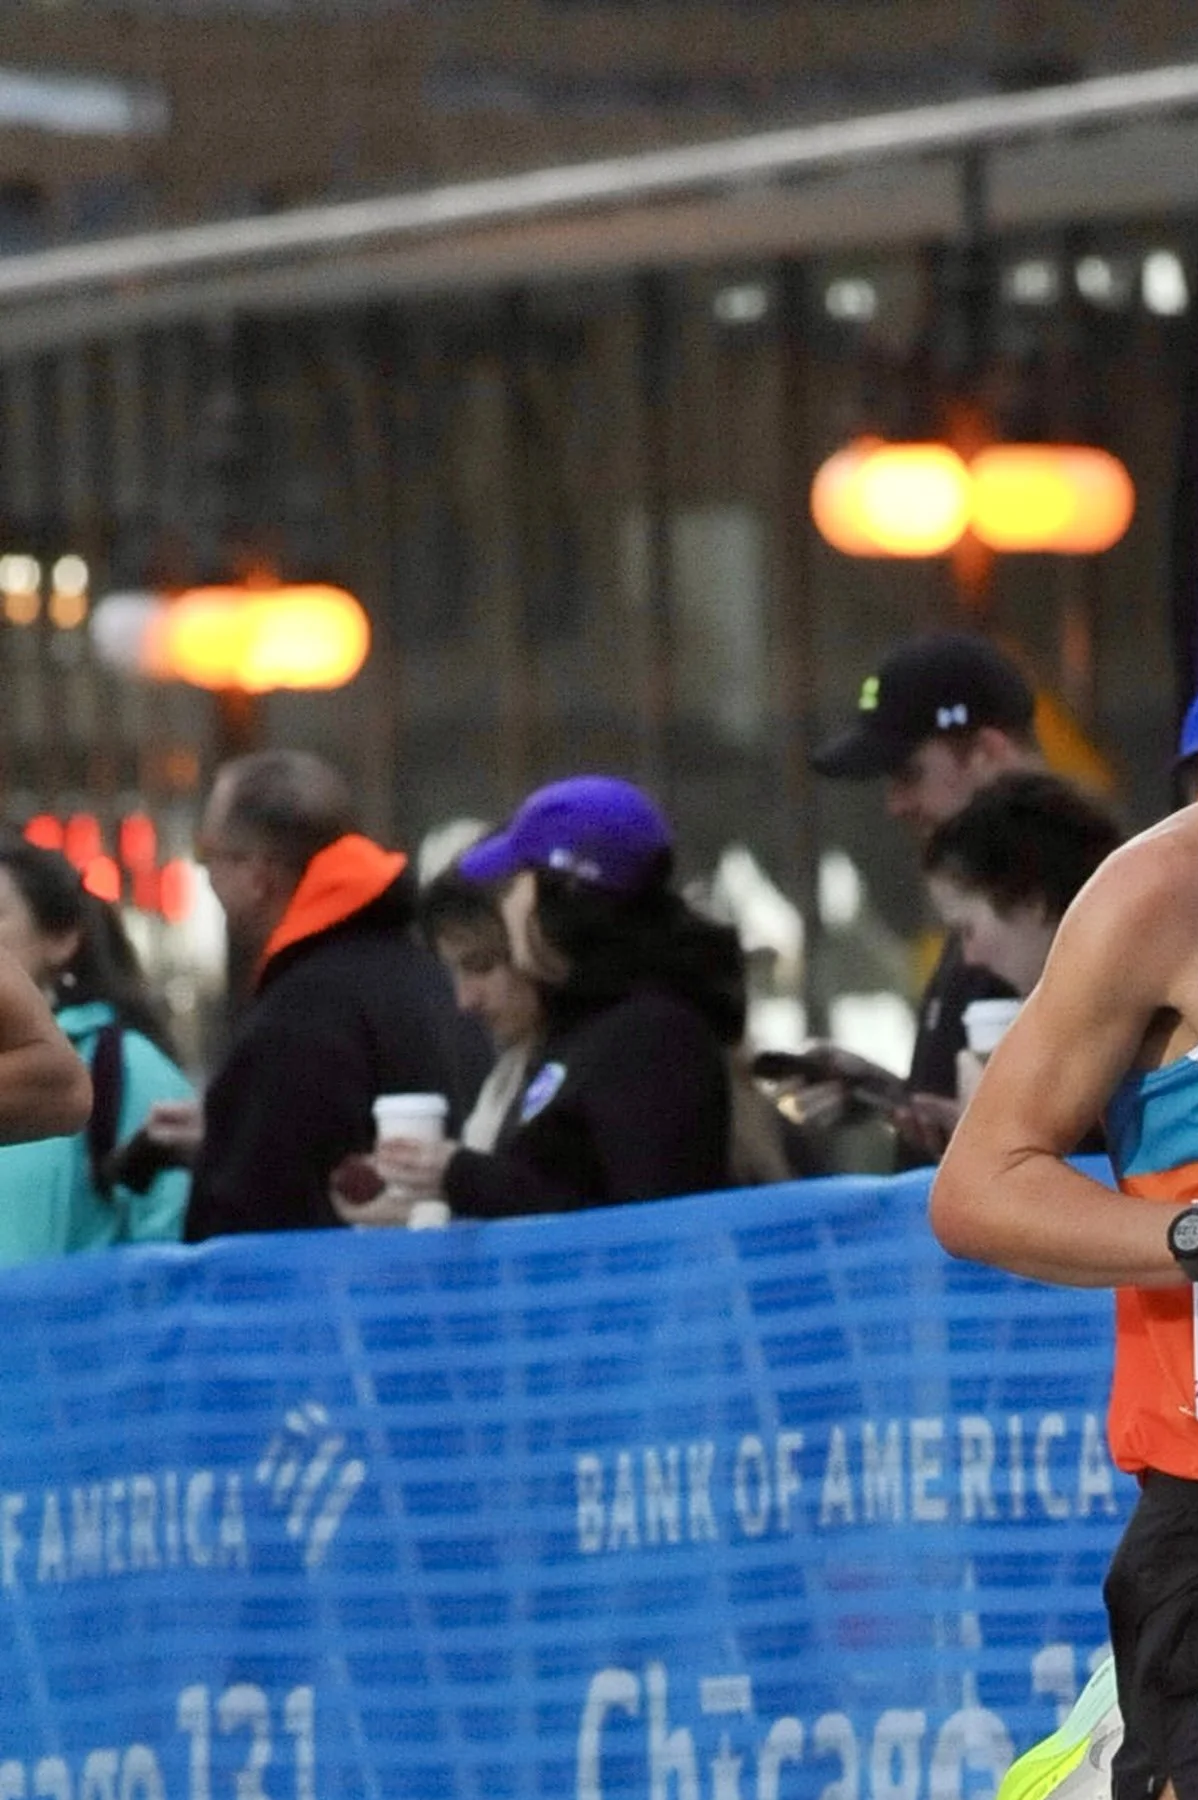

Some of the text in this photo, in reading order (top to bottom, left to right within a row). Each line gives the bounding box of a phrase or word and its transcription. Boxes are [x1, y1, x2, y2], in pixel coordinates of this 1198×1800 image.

[36, 1470, 248, 1583] AMERICA
[576, 1413, 1118, 1553] BANK OF AMERICA
